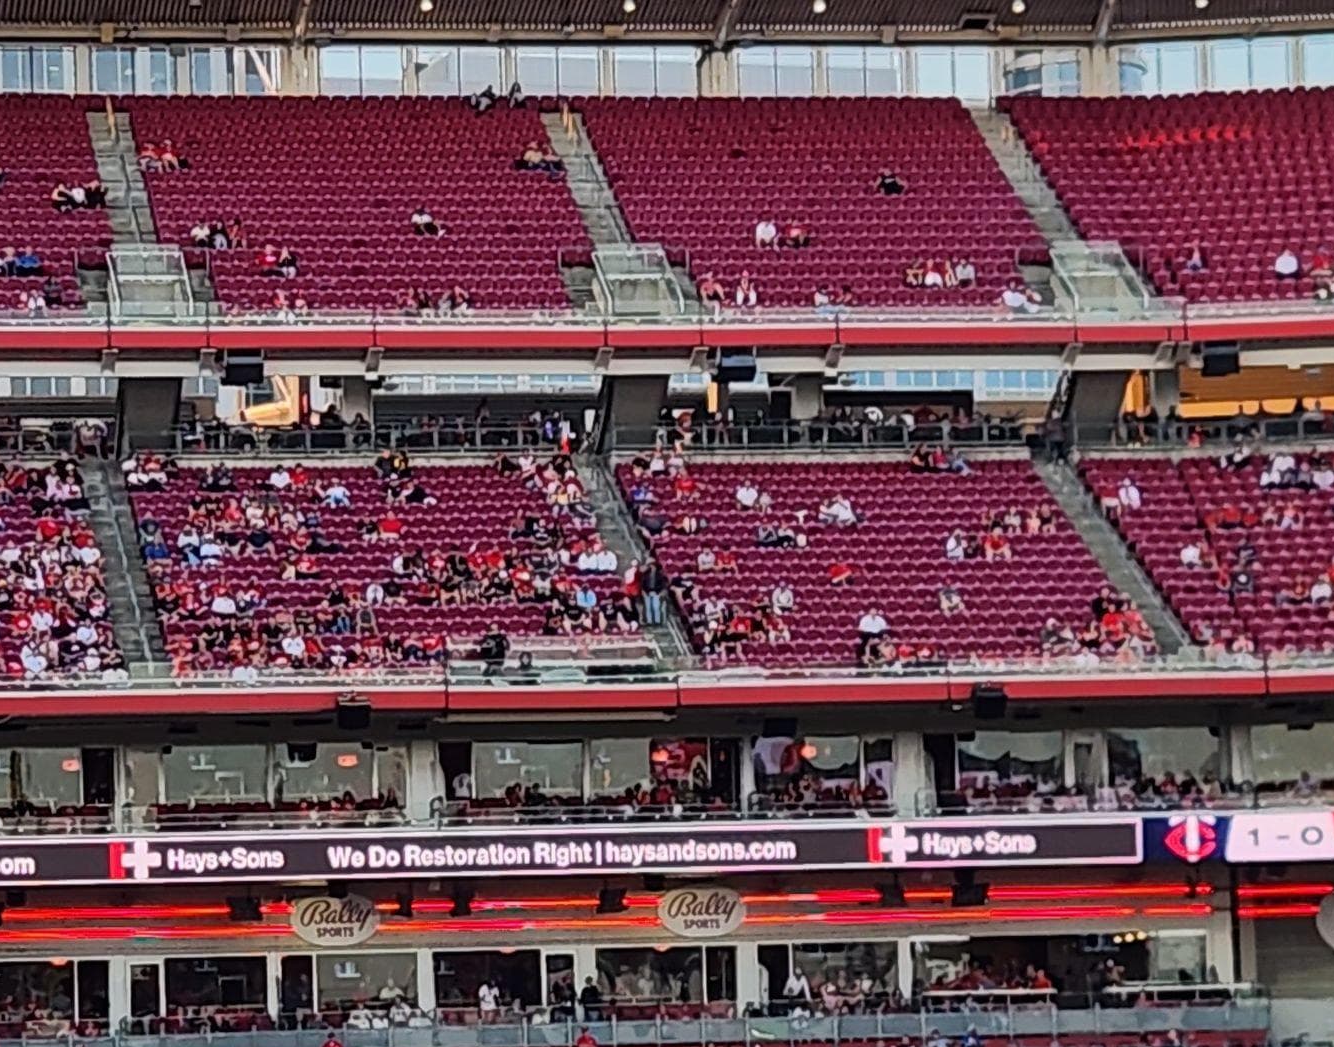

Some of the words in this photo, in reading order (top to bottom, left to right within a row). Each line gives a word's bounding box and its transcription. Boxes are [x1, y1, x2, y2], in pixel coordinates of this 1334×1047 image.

[327, 846, 366, 868] We
[367, 845, 401, 867] Do
[403, 843, 531, 866] Restoration
[533, 841, 593, 867] Right
[605, 839, 797, 867] haysandsons.com
[922, 830, 1037, 858] Hays+Sons
[167, 847, 285, 874] Hays+Sons
[300, 899, 372, 931] Bally
[667, 891, 737, 924] Bally
[315, 926, 355, 938] SPORTS
